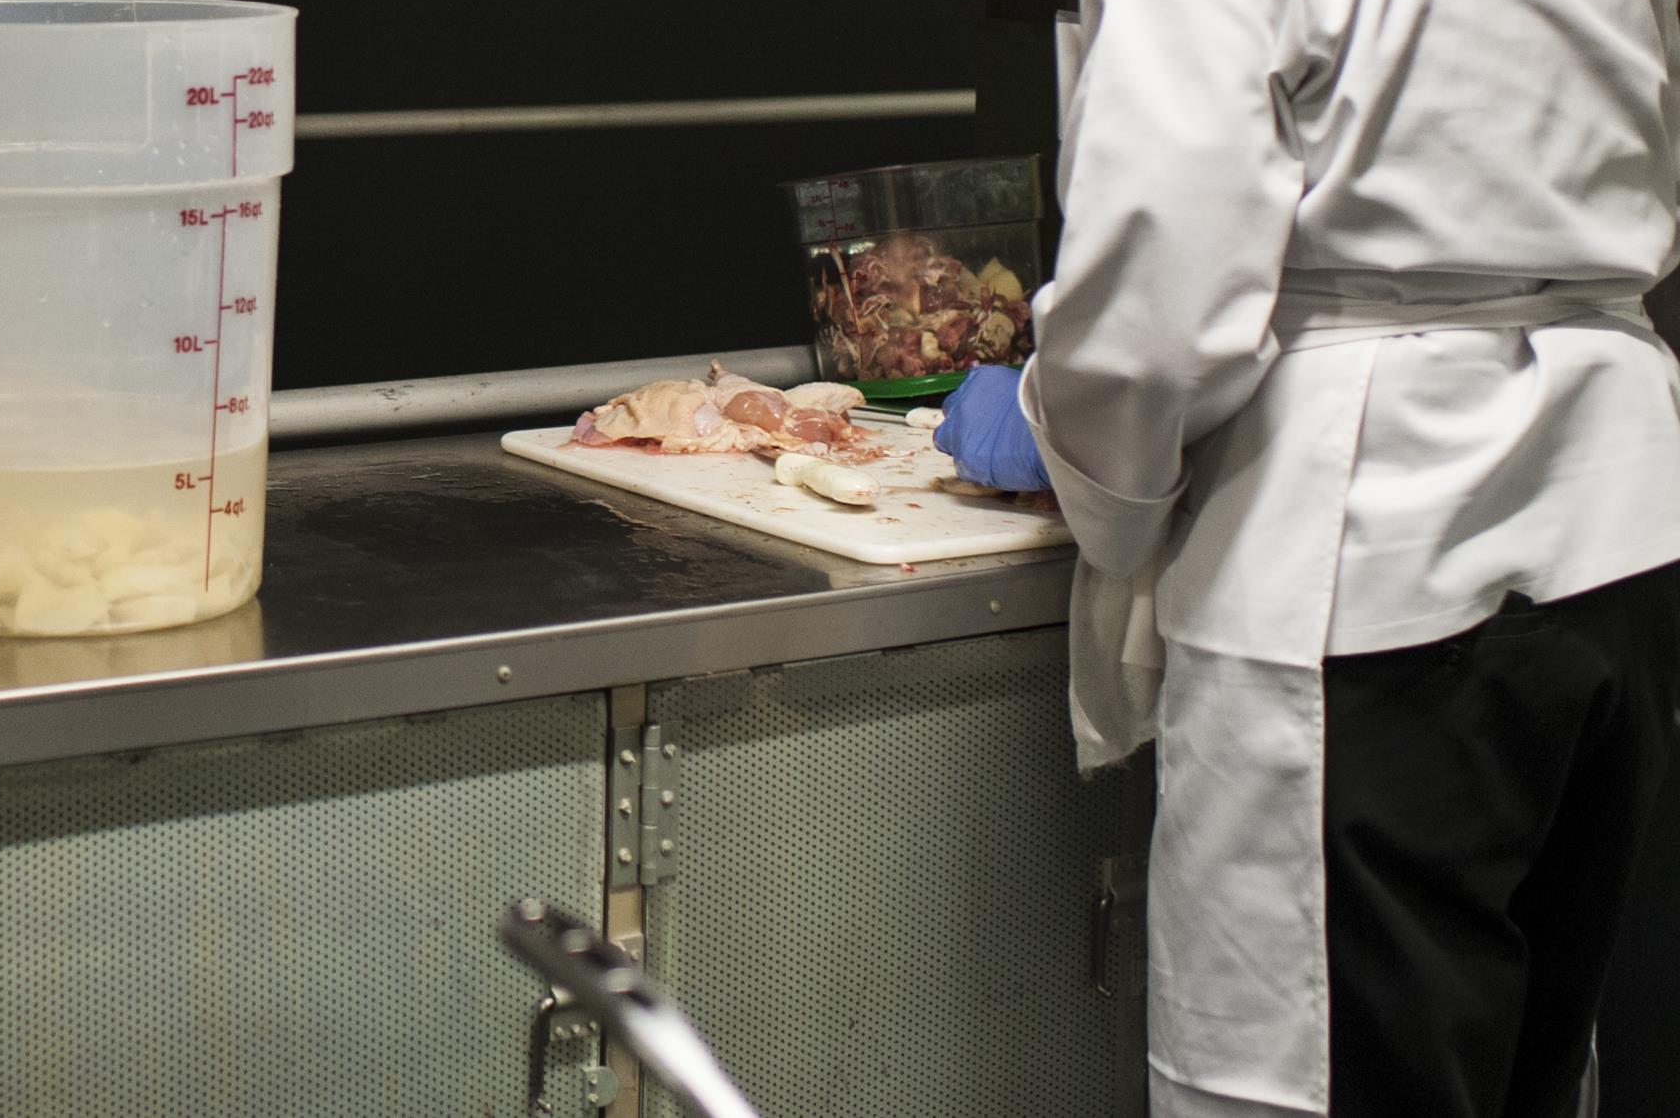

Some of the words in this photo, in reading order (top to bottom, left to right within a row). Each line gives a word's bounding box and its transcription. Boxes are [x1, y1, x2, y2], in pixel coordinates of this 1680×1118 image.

[186, 87, 219, 106] 20L
[179, 209, 208, 226] 15L
[174, 336, 203, 353] 10L
[175, 472, 196, 490] 5L
